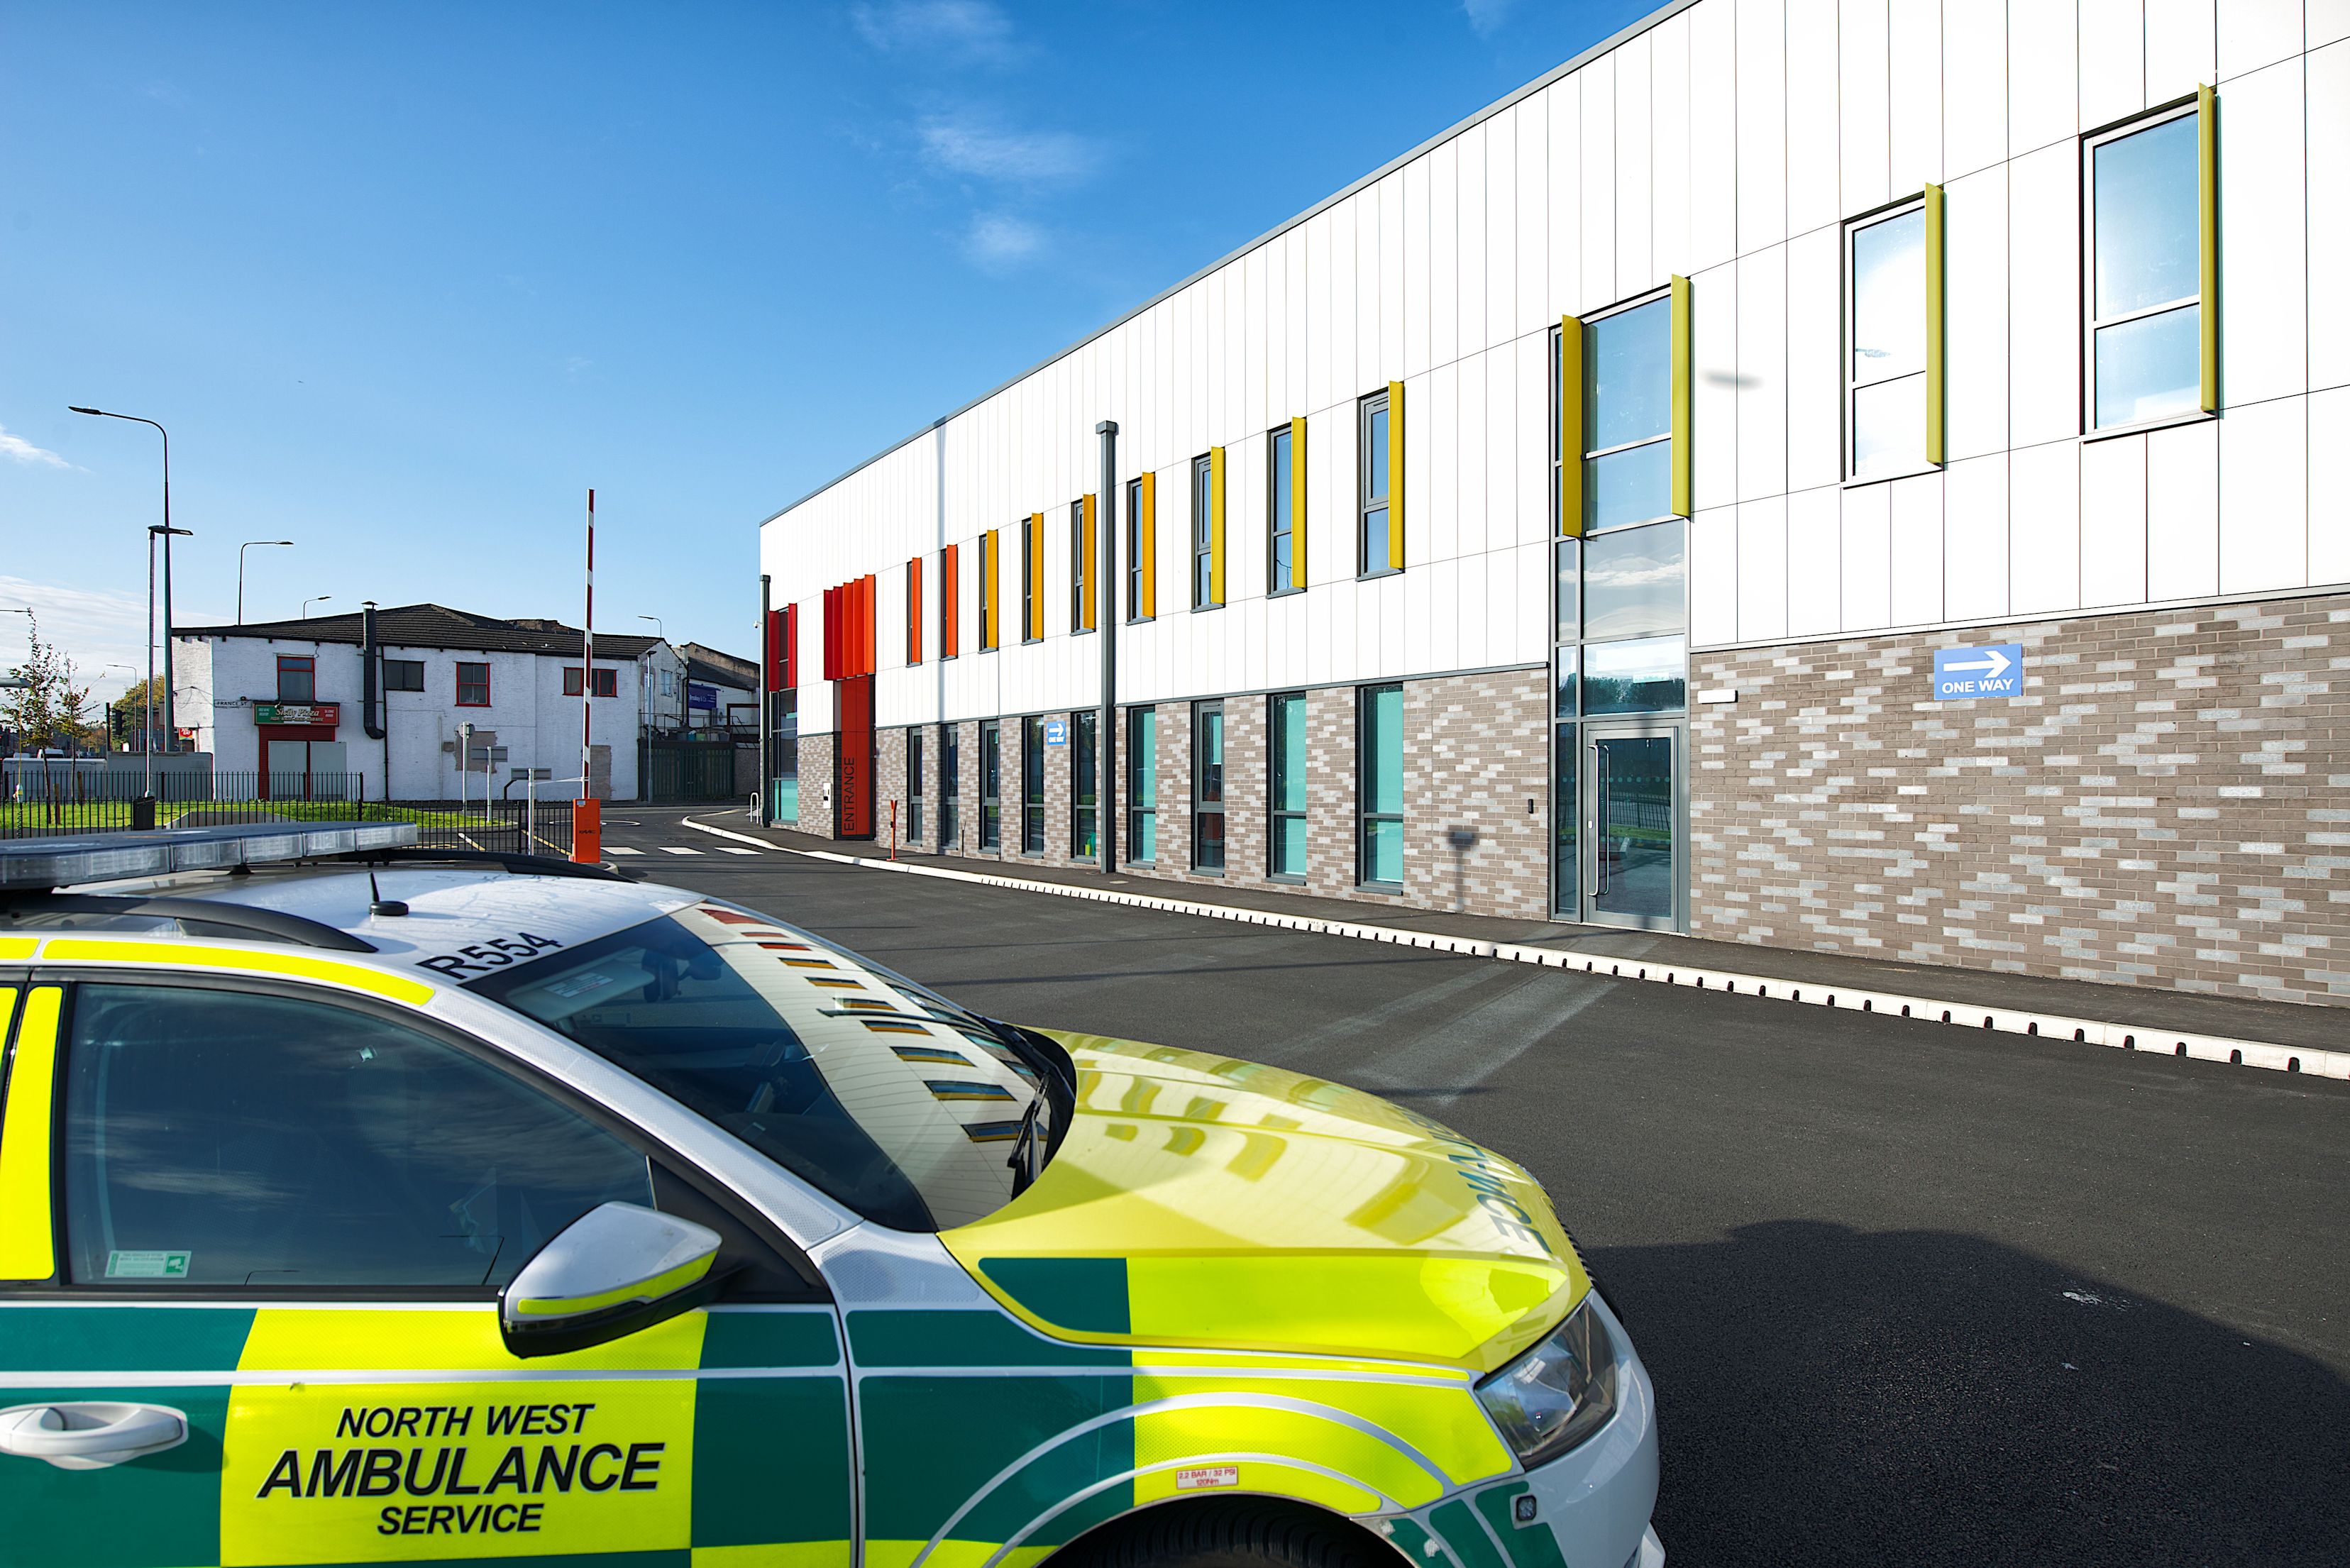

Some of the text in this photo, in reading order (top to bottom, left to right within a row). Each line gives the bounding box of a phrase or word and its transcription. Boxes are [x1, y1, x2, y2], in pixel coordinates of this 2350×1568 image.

[1942, 678, 2014, 694] ONE WAY
[275, 708, 296, 717] Sicily
[298, 708, 320, 717] Pizza
[844, 757, 854, 832] ENTRANCE
[414, 932, 563, 980] R554
[335, 1403, 595, 1438] NORTH WEST
[255, 1442, 666, 1499] AMBULANCE
[377, 1503, 544, 1535] SERVICE
